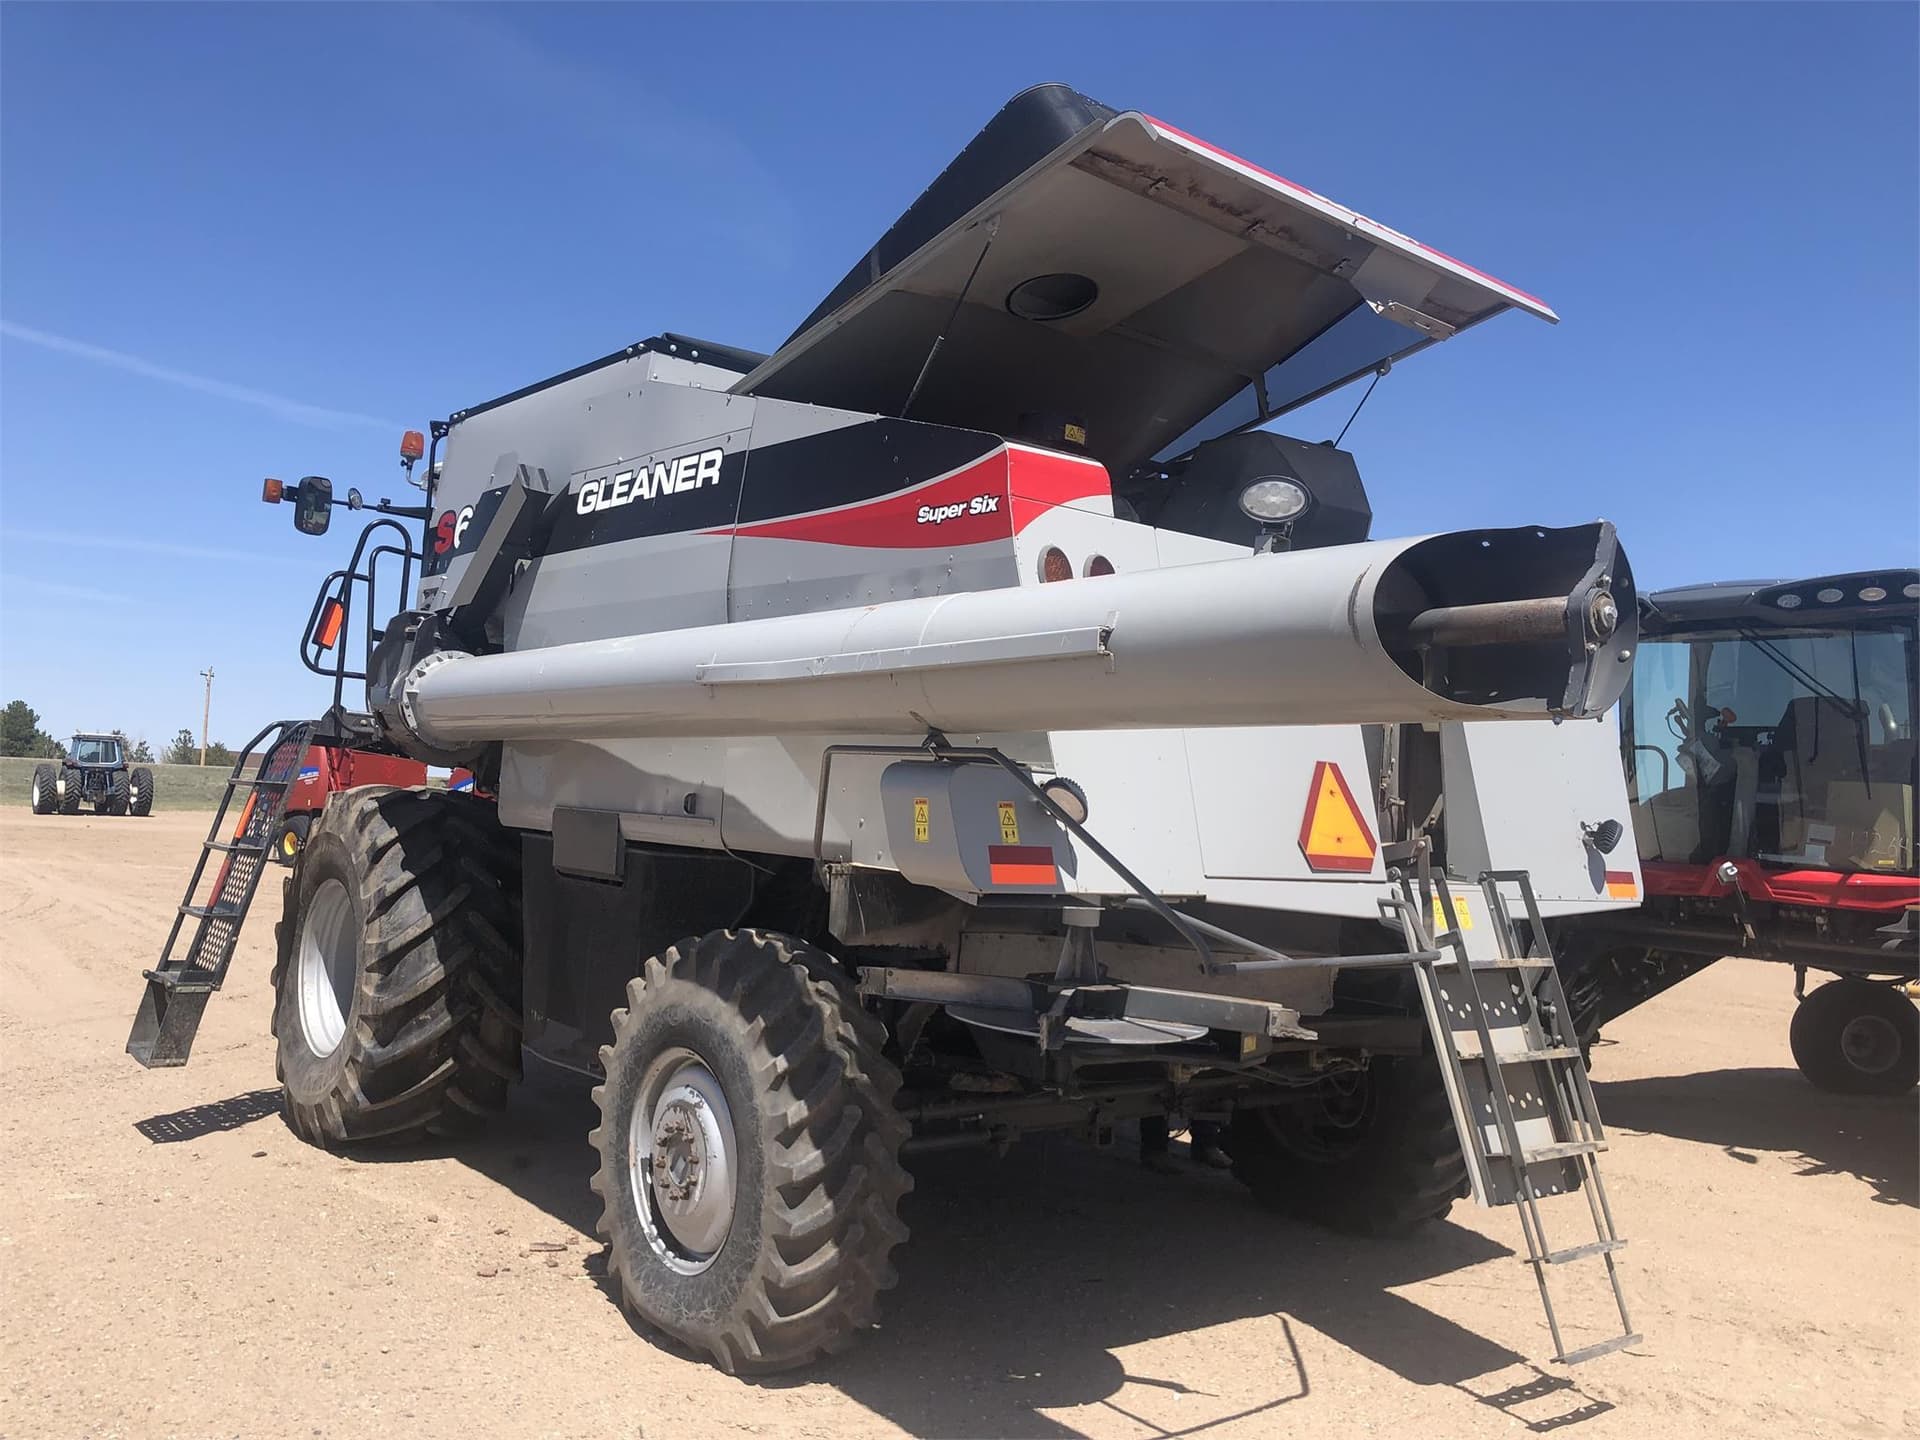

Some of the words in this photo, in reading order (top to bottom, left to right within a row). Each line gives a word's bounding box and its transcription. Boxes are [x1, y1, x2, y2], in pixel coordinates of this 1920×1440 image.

[576, 449, 724, 515] GLEANER
[917, 502, 967, 524] Super
[968, 494, 1000, 515] Six
